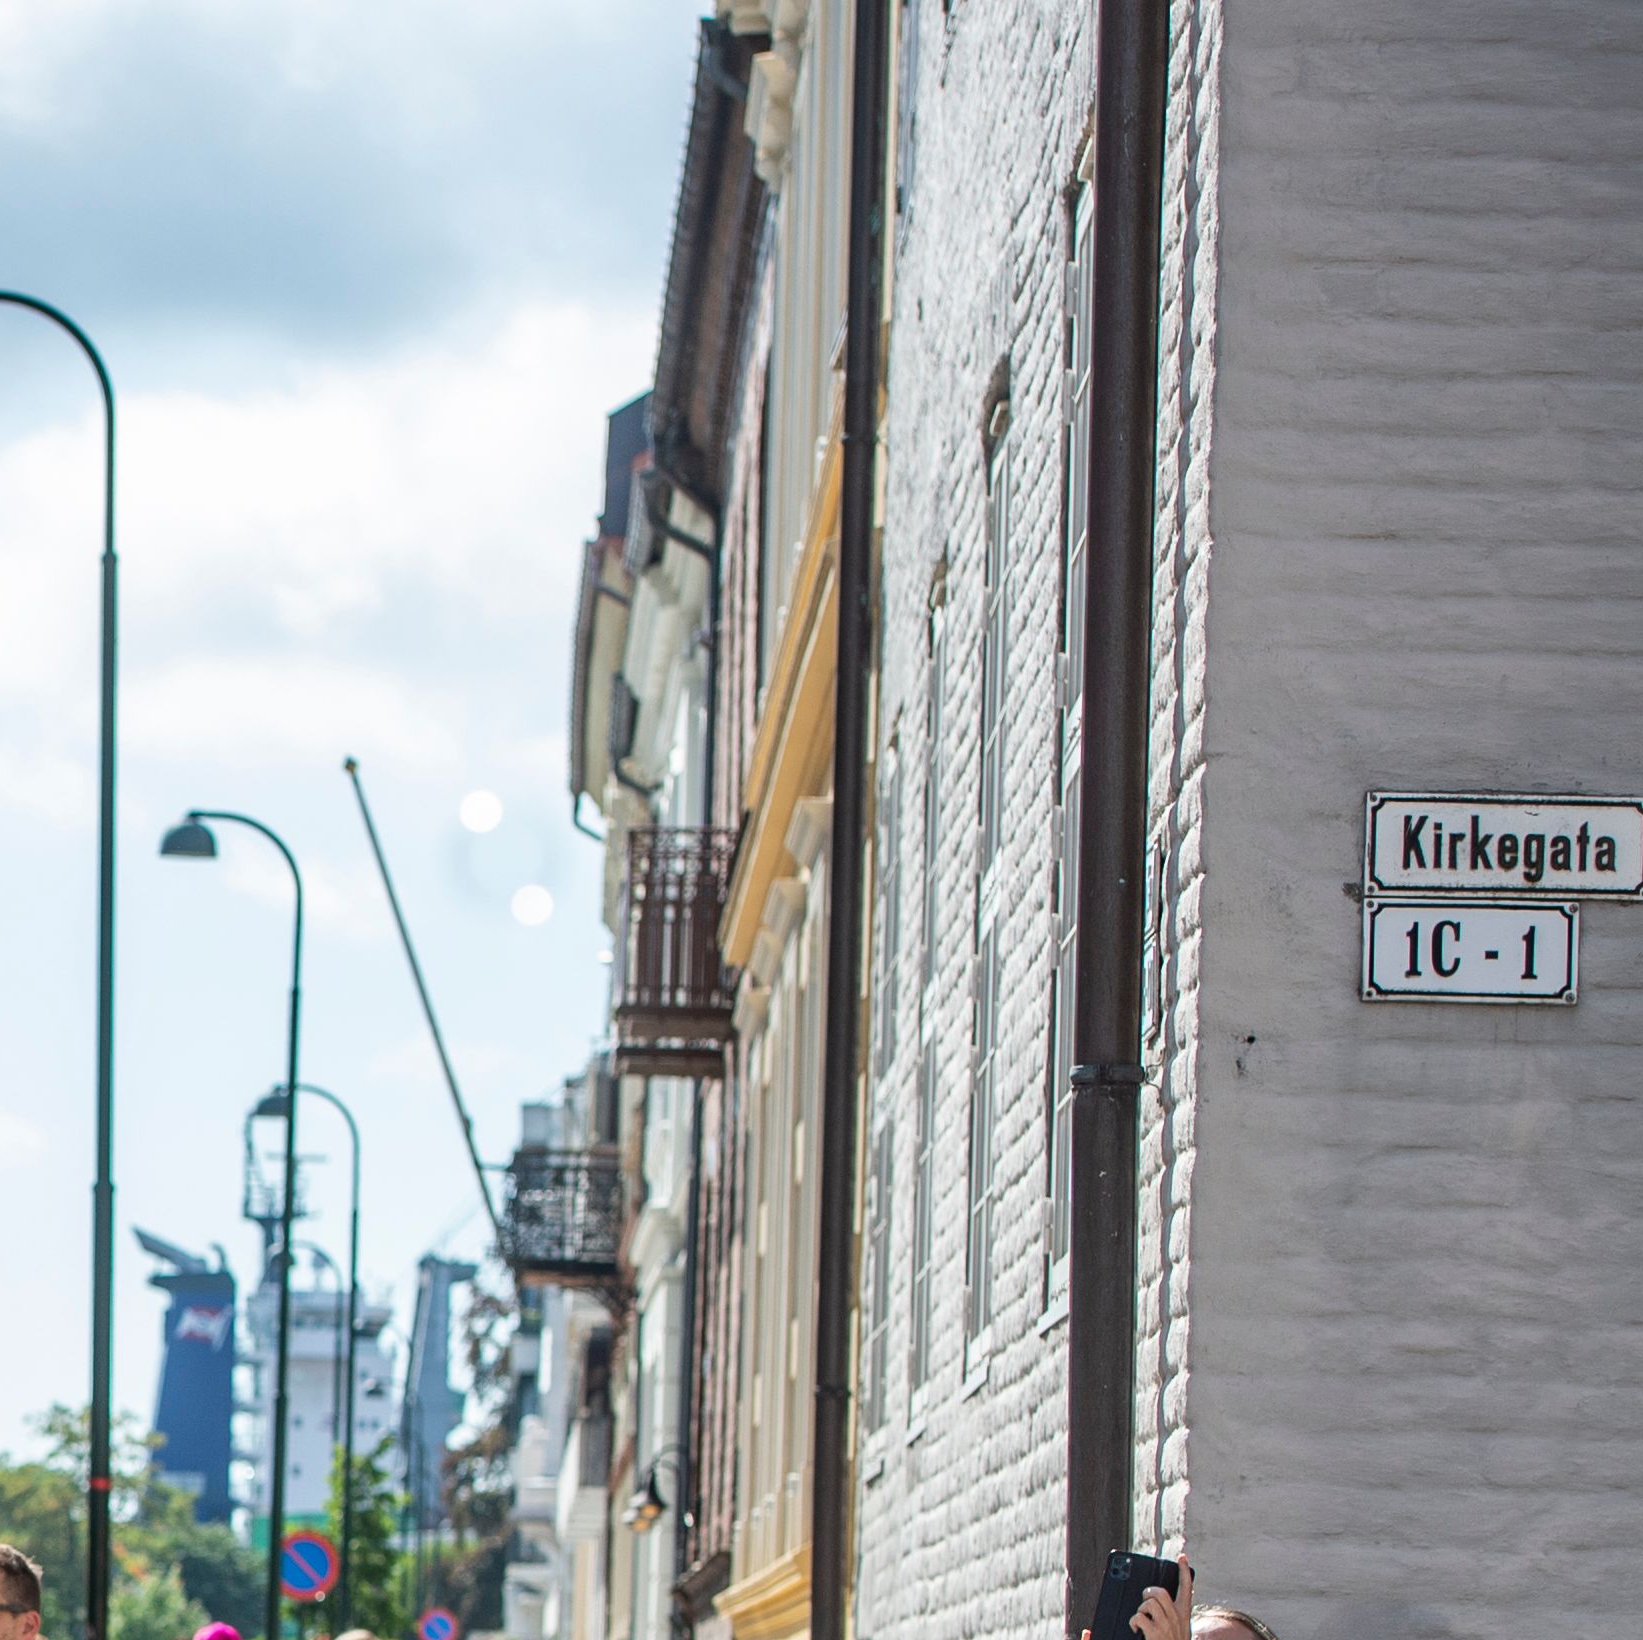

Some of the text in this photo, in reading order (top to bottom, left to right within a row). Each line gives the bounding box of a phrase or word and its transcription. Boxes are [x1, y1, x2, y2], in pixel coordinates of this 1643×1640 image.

[1402, 814, 1617, 883] Kirkegata
[1404, 920, 1462, 979] 1C
[1520, 925, 1538, 980] 1
